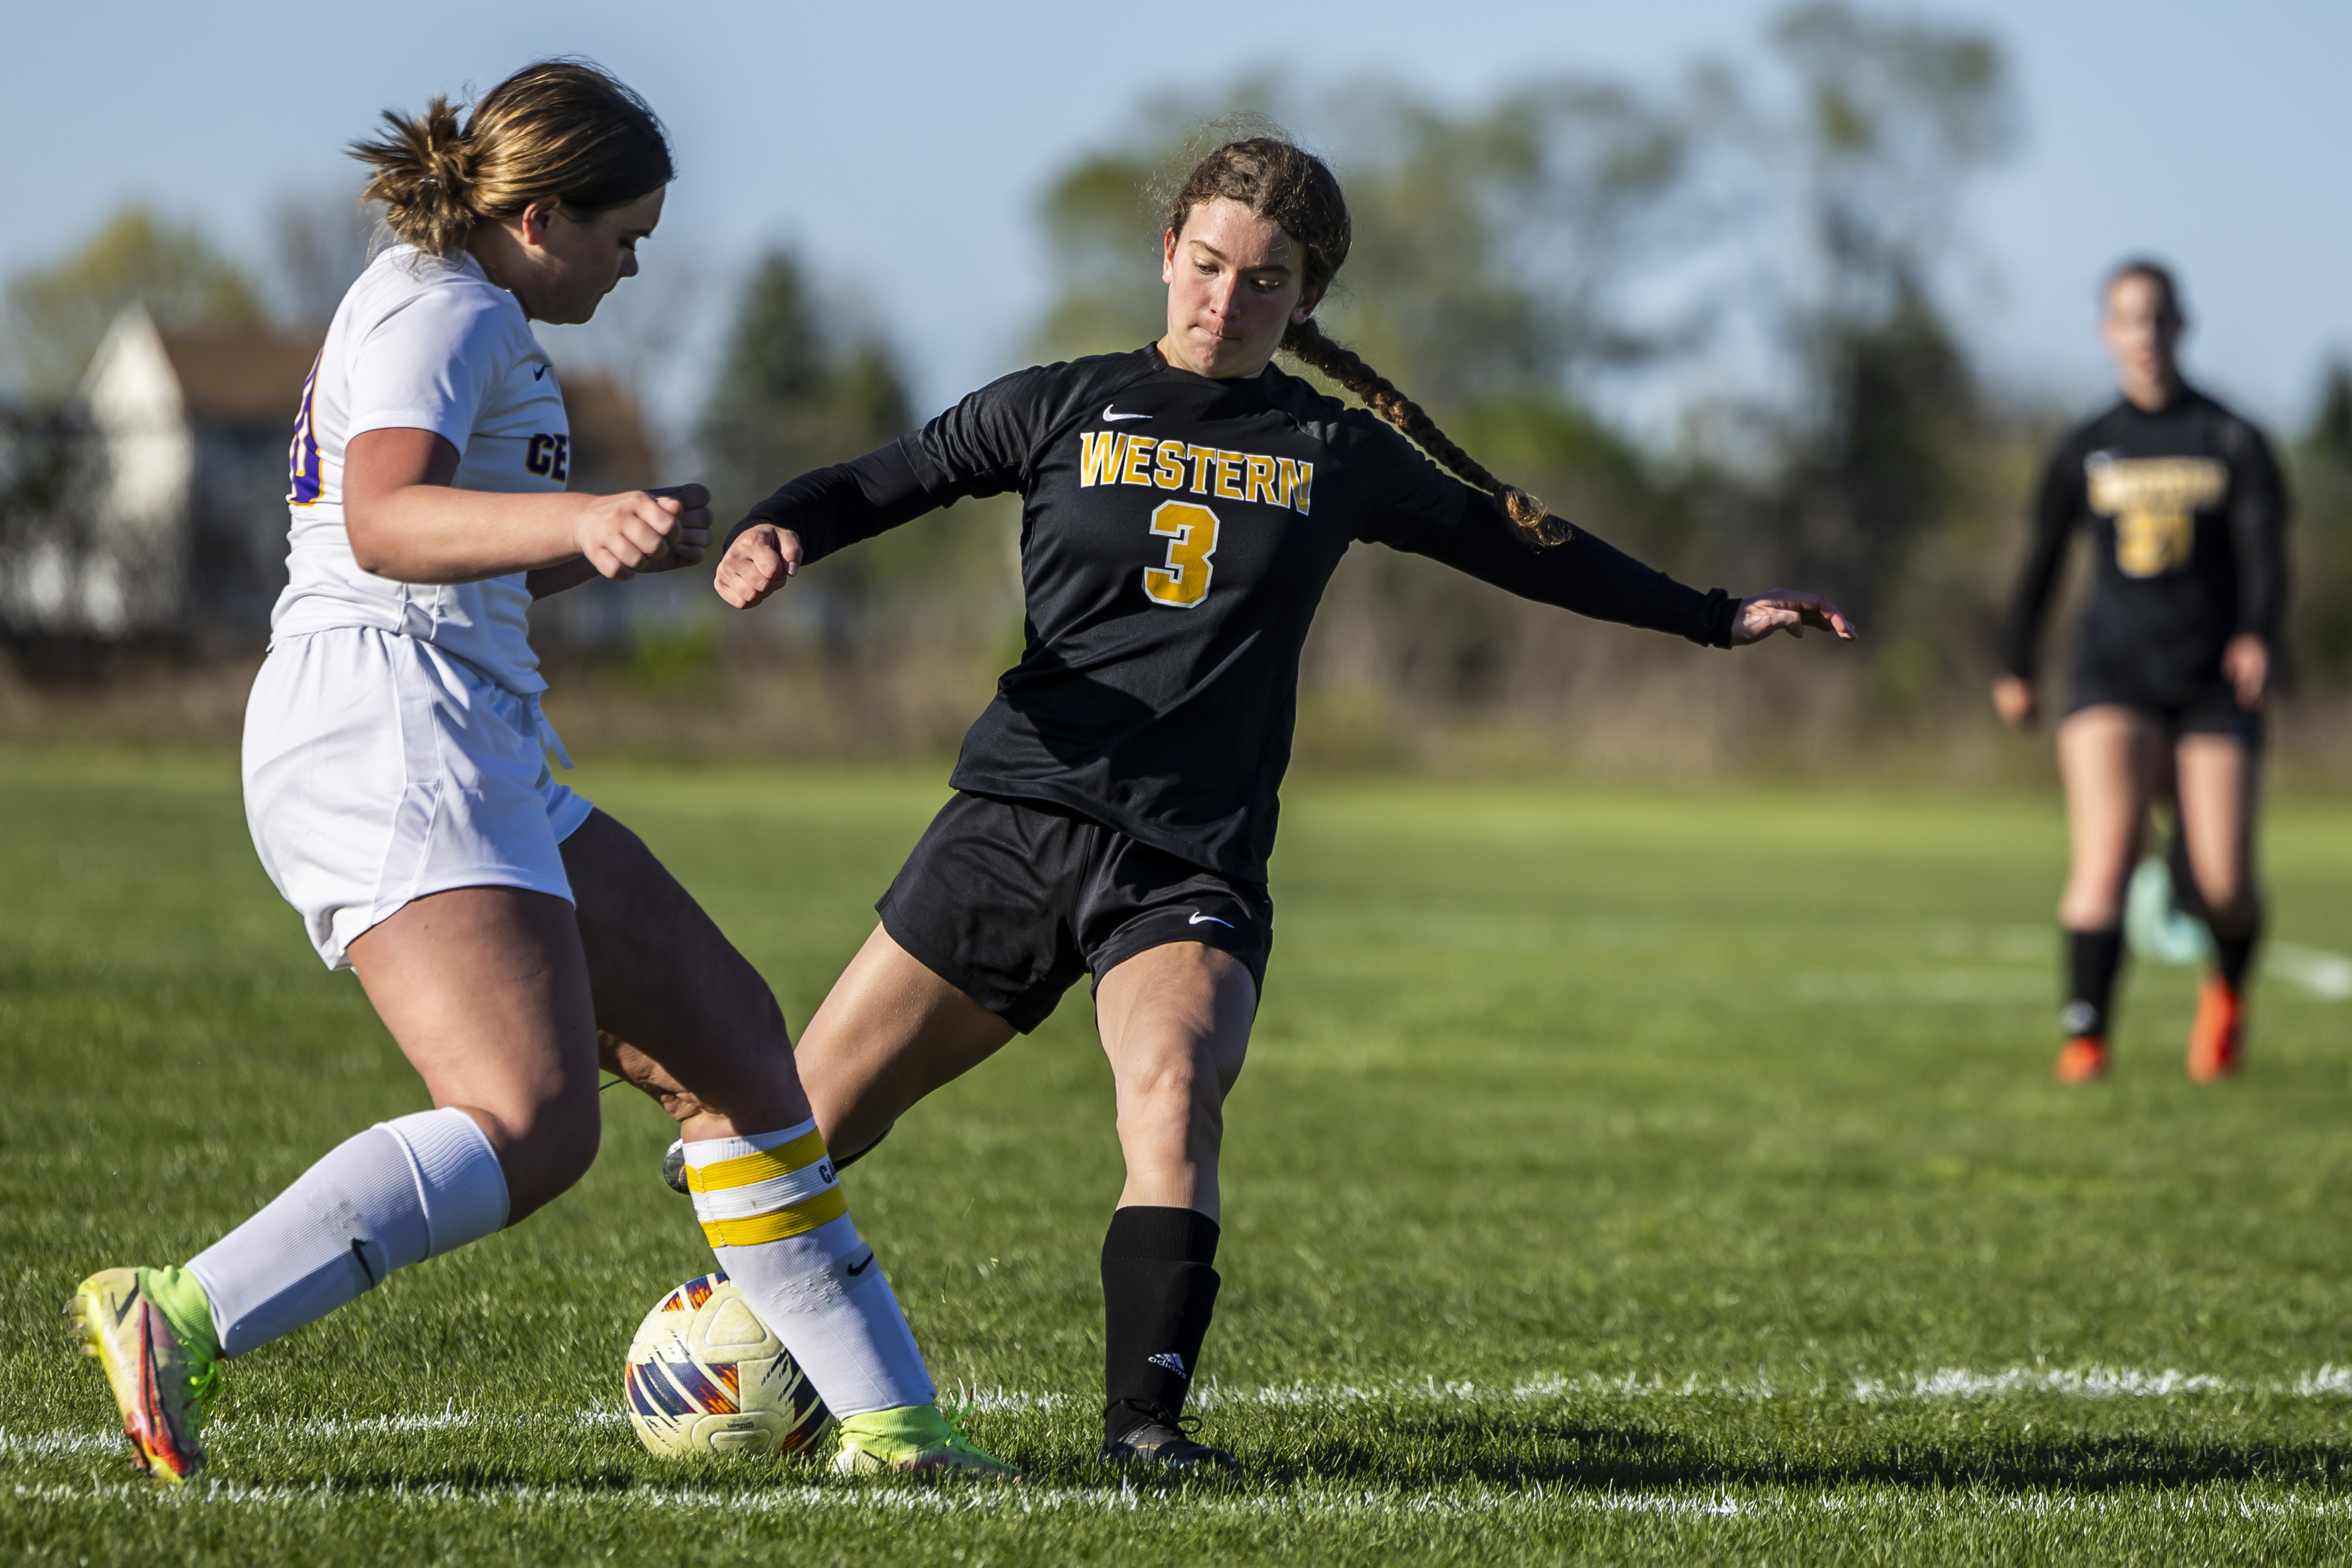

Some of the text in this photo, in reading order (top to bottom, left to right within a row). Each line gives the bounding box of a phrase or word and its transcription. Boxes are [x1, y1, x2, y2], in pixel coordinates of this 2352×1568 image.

[1080, 431, 1313, 516] WESTERN
[1142, 499, 1220, 608] 3
[1148, 1356, 1186, 1379] adidas
